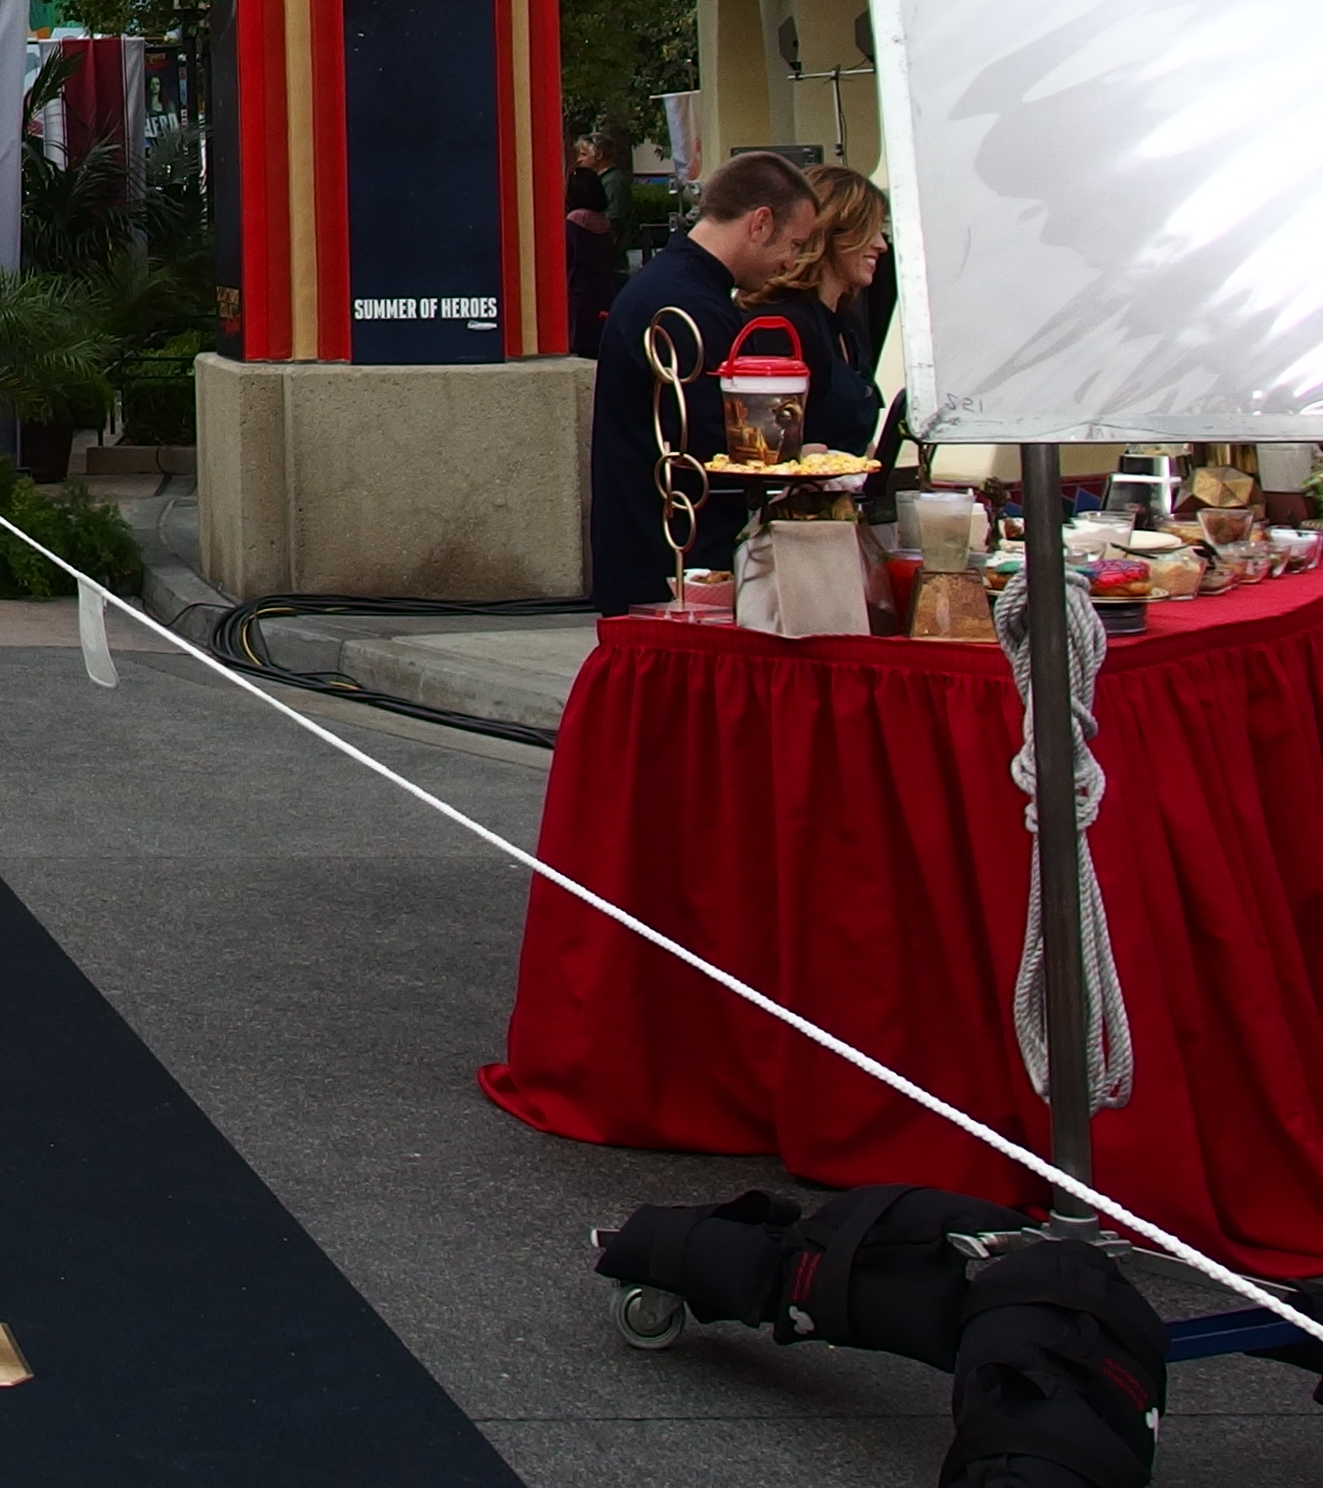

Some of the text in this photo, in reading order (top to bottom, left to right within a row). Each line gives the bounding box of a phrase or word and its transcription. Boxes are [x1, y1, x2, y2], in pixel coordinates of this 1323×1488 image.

[354, 296, 498, 320] SUMMER OF HEROES
